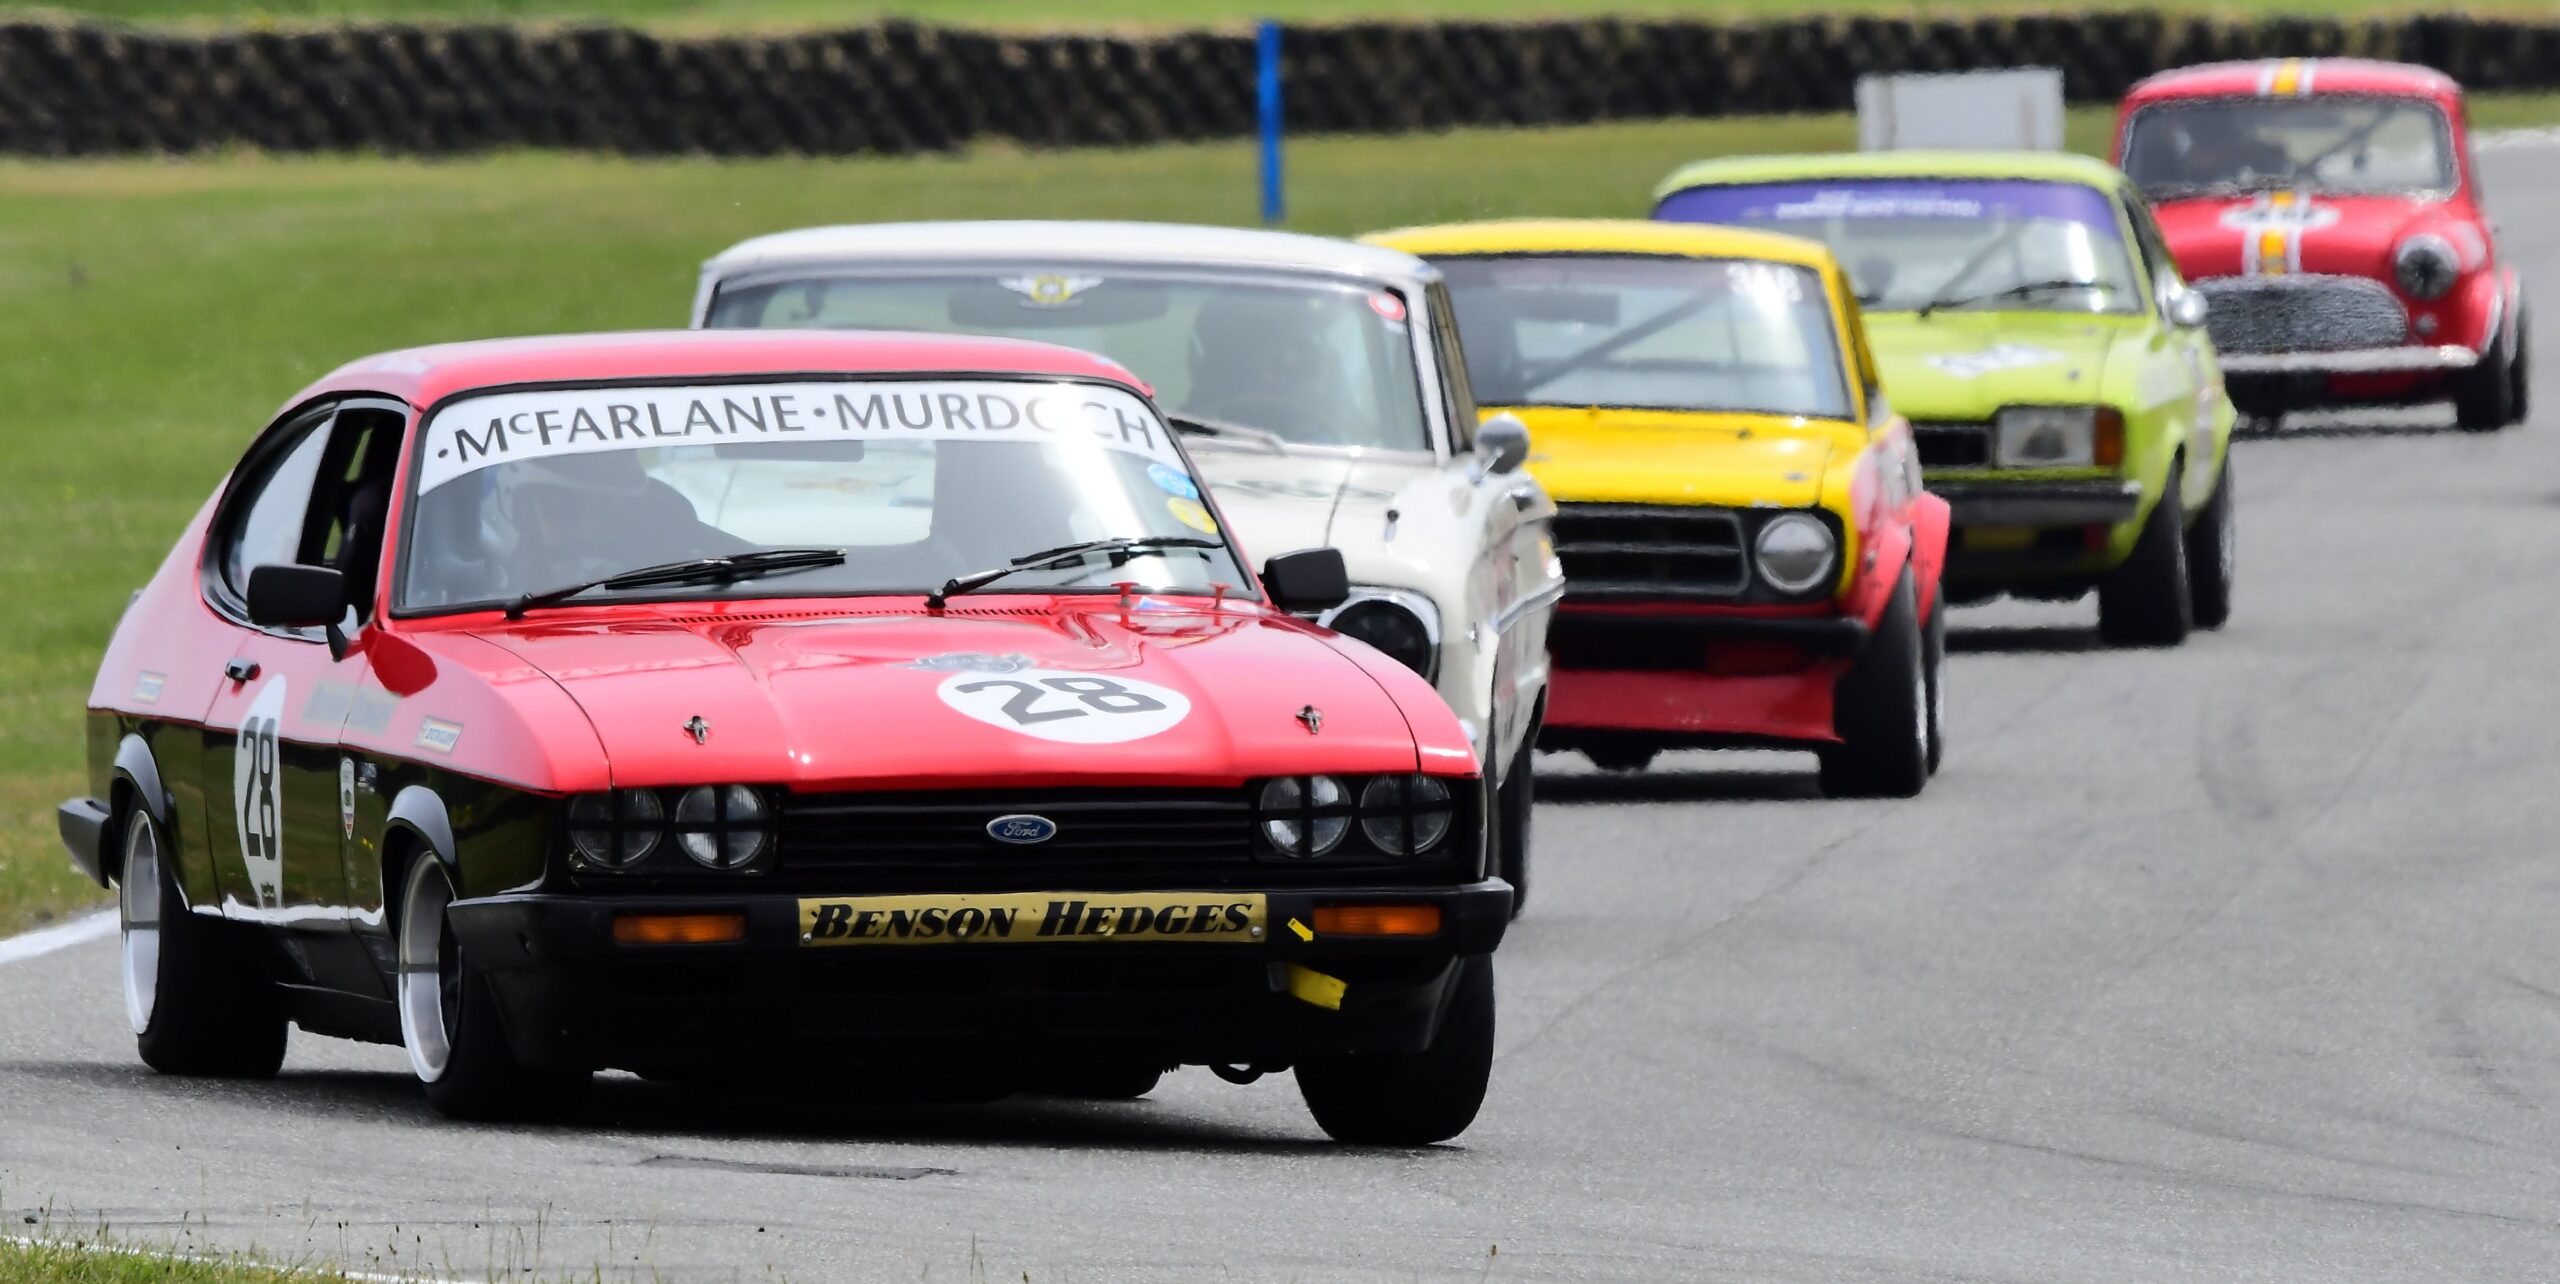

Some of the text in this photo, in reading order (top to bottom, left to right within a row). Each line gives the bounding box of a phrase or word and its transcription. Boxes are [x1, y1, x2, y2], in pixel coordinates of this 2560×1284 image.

[954, 676, 1168, 726] 28
[242, 715, 277, 861] 28
[1003, 821, 1041, 837] Ford
[811, 901, 1253, 939] BENSON HEDGES
